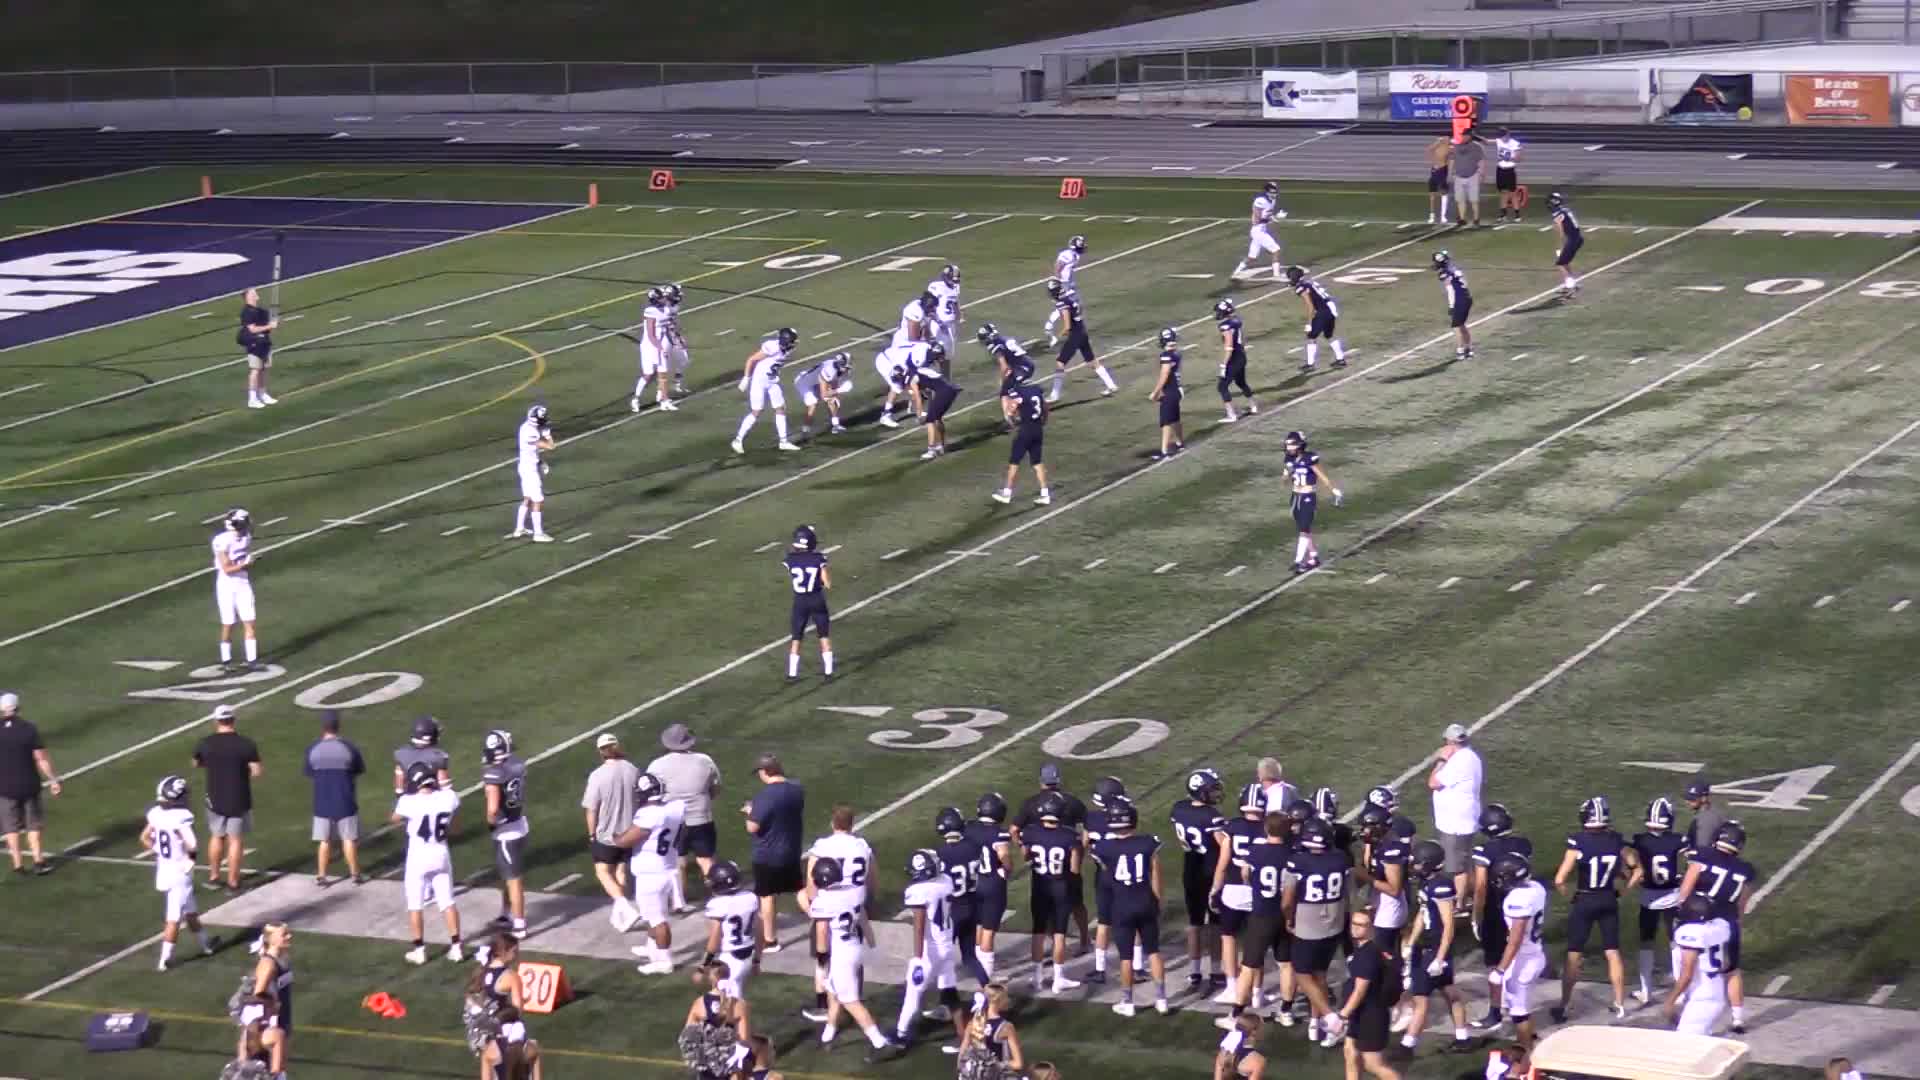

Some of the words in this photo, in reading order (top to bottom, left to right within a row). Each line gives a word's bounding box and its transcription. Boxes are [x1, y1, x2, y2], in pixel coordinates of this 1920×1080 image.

[653, 172, 666, 186] G
[1062, 181, 1080, 197] 10
[790, 567, 818, 593] 27
[416, 811, 451, 843] 46
[1030, 845, 1065, 875] 38
[1115, 853, 1144, 885] 41
[1588, 855, 1618, 888] 17
[1651, 855, 1670, 881] 6
[1305, 872, 1343, 902] 68
[1709, 865, 1746, 902] 77
[520, 967, 552, 1006] 30
